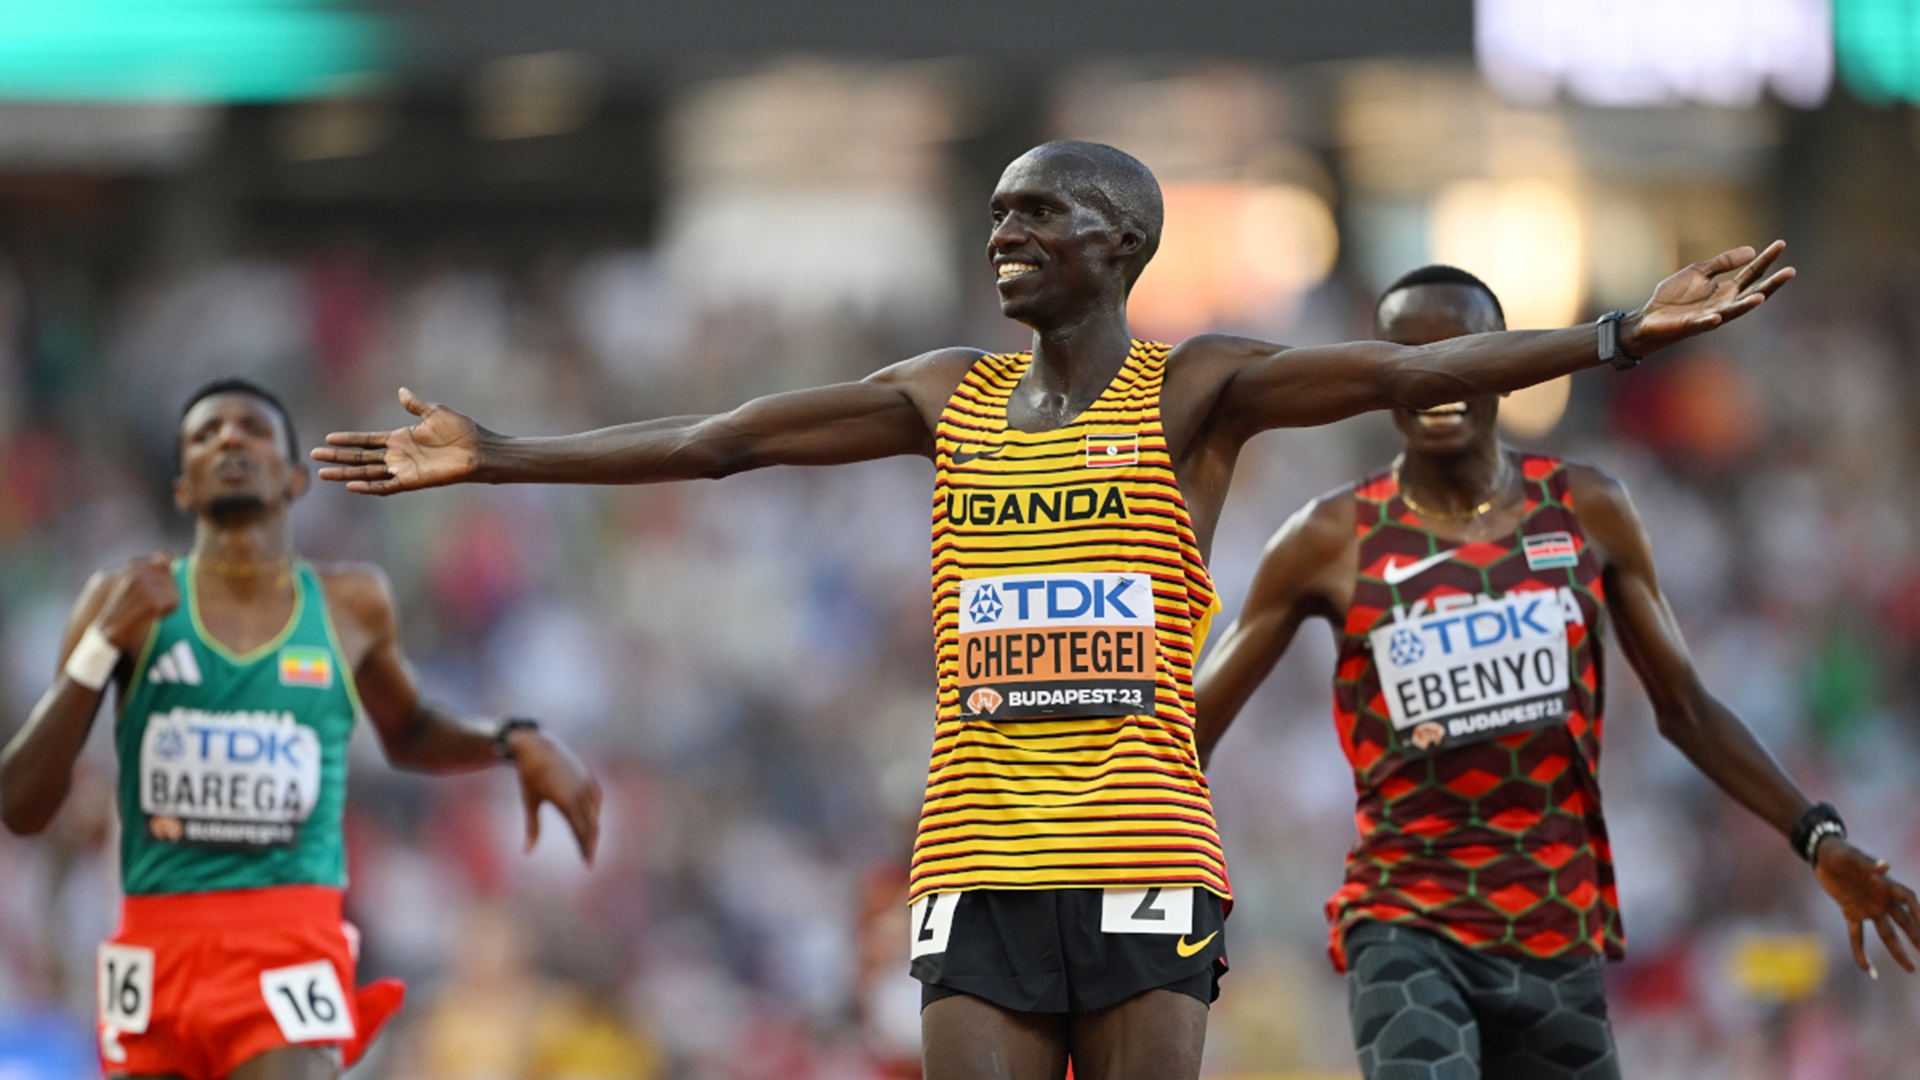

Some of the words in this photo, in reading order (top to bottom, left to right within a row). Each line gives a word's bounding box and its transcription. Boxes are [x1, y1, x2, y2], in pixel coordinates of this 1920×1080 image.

[947, 486, 1127, 525] UGANDA
[1002, 579, 1138, 620] TDK
[1421, 598, 1550, 655] TDK
[966, 630, 1144, 679] CHEPTEGEI
[1008, 689, 1117, 707] BUDAPEST
[1119, 689, 1143, 704] 23
[1396, 647, 1555, 719] EBENYO
[1448, 700, 1545, 737] BUDAPEST
[187, 722, 302, 768] TDK
[151, 769, 302, 813] BAREGA
[106, 959, 141, 1017] 16
[275, 977, 337, 1026] 16
